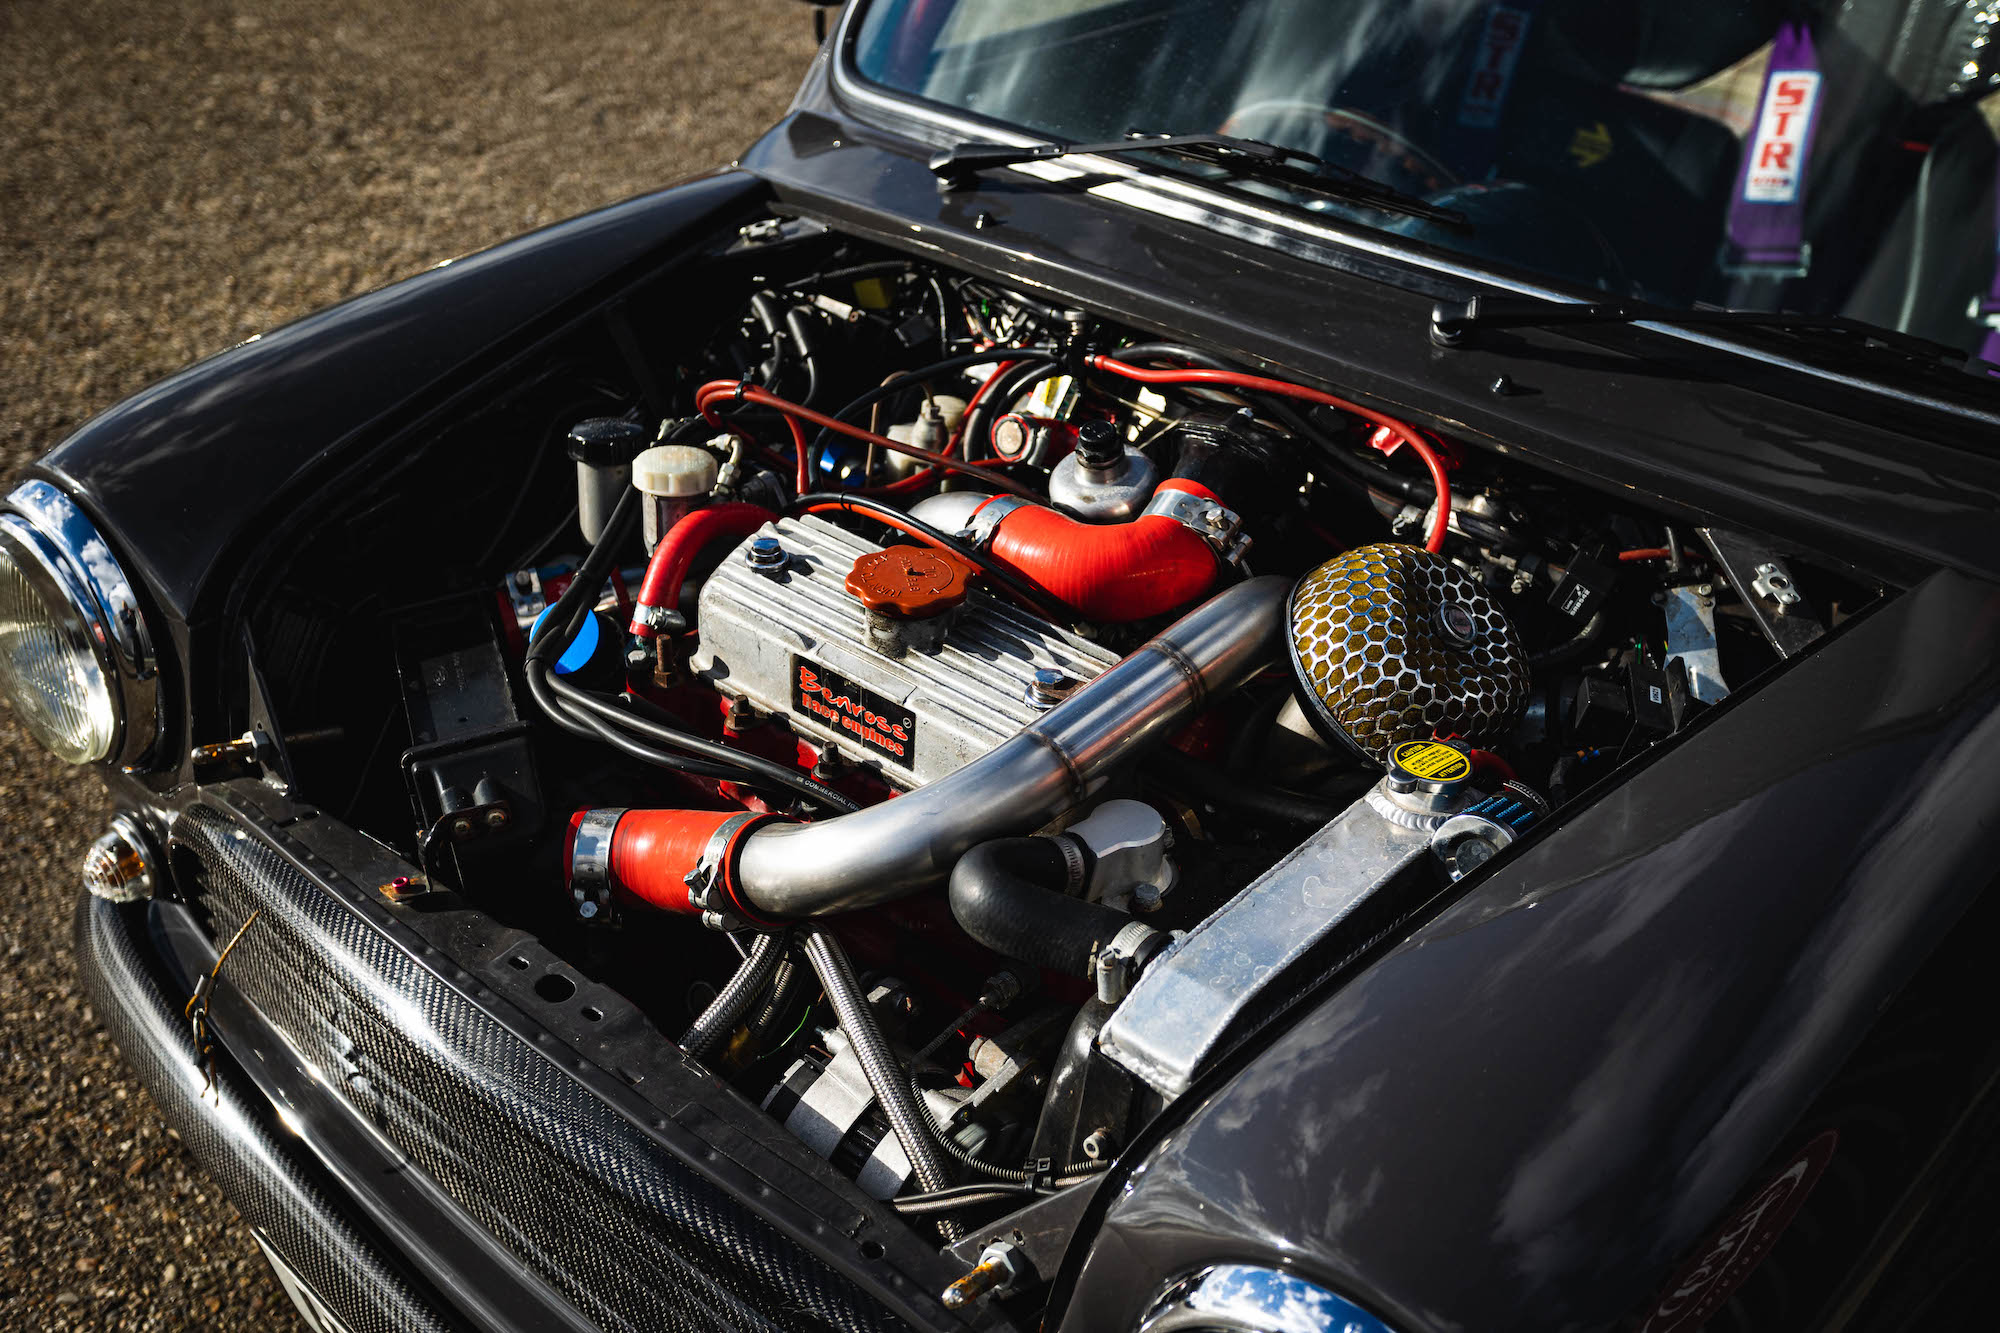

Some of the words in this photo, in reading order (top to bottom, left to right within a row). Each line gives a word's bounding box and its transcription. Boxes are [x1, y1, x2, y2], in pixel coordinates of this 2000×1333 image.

[1760, 79, 1811, 169] STR
[798, 665, 909, 742] Benross
[801, 692, 840, 723] Race
[841, 714, 905, 757] engines
[1400, 744, 1426, 757] CAUTION
[1438, 762, 1466, 778] ATTENTION
[804, 779, 847, 805] COMMERCIAL
